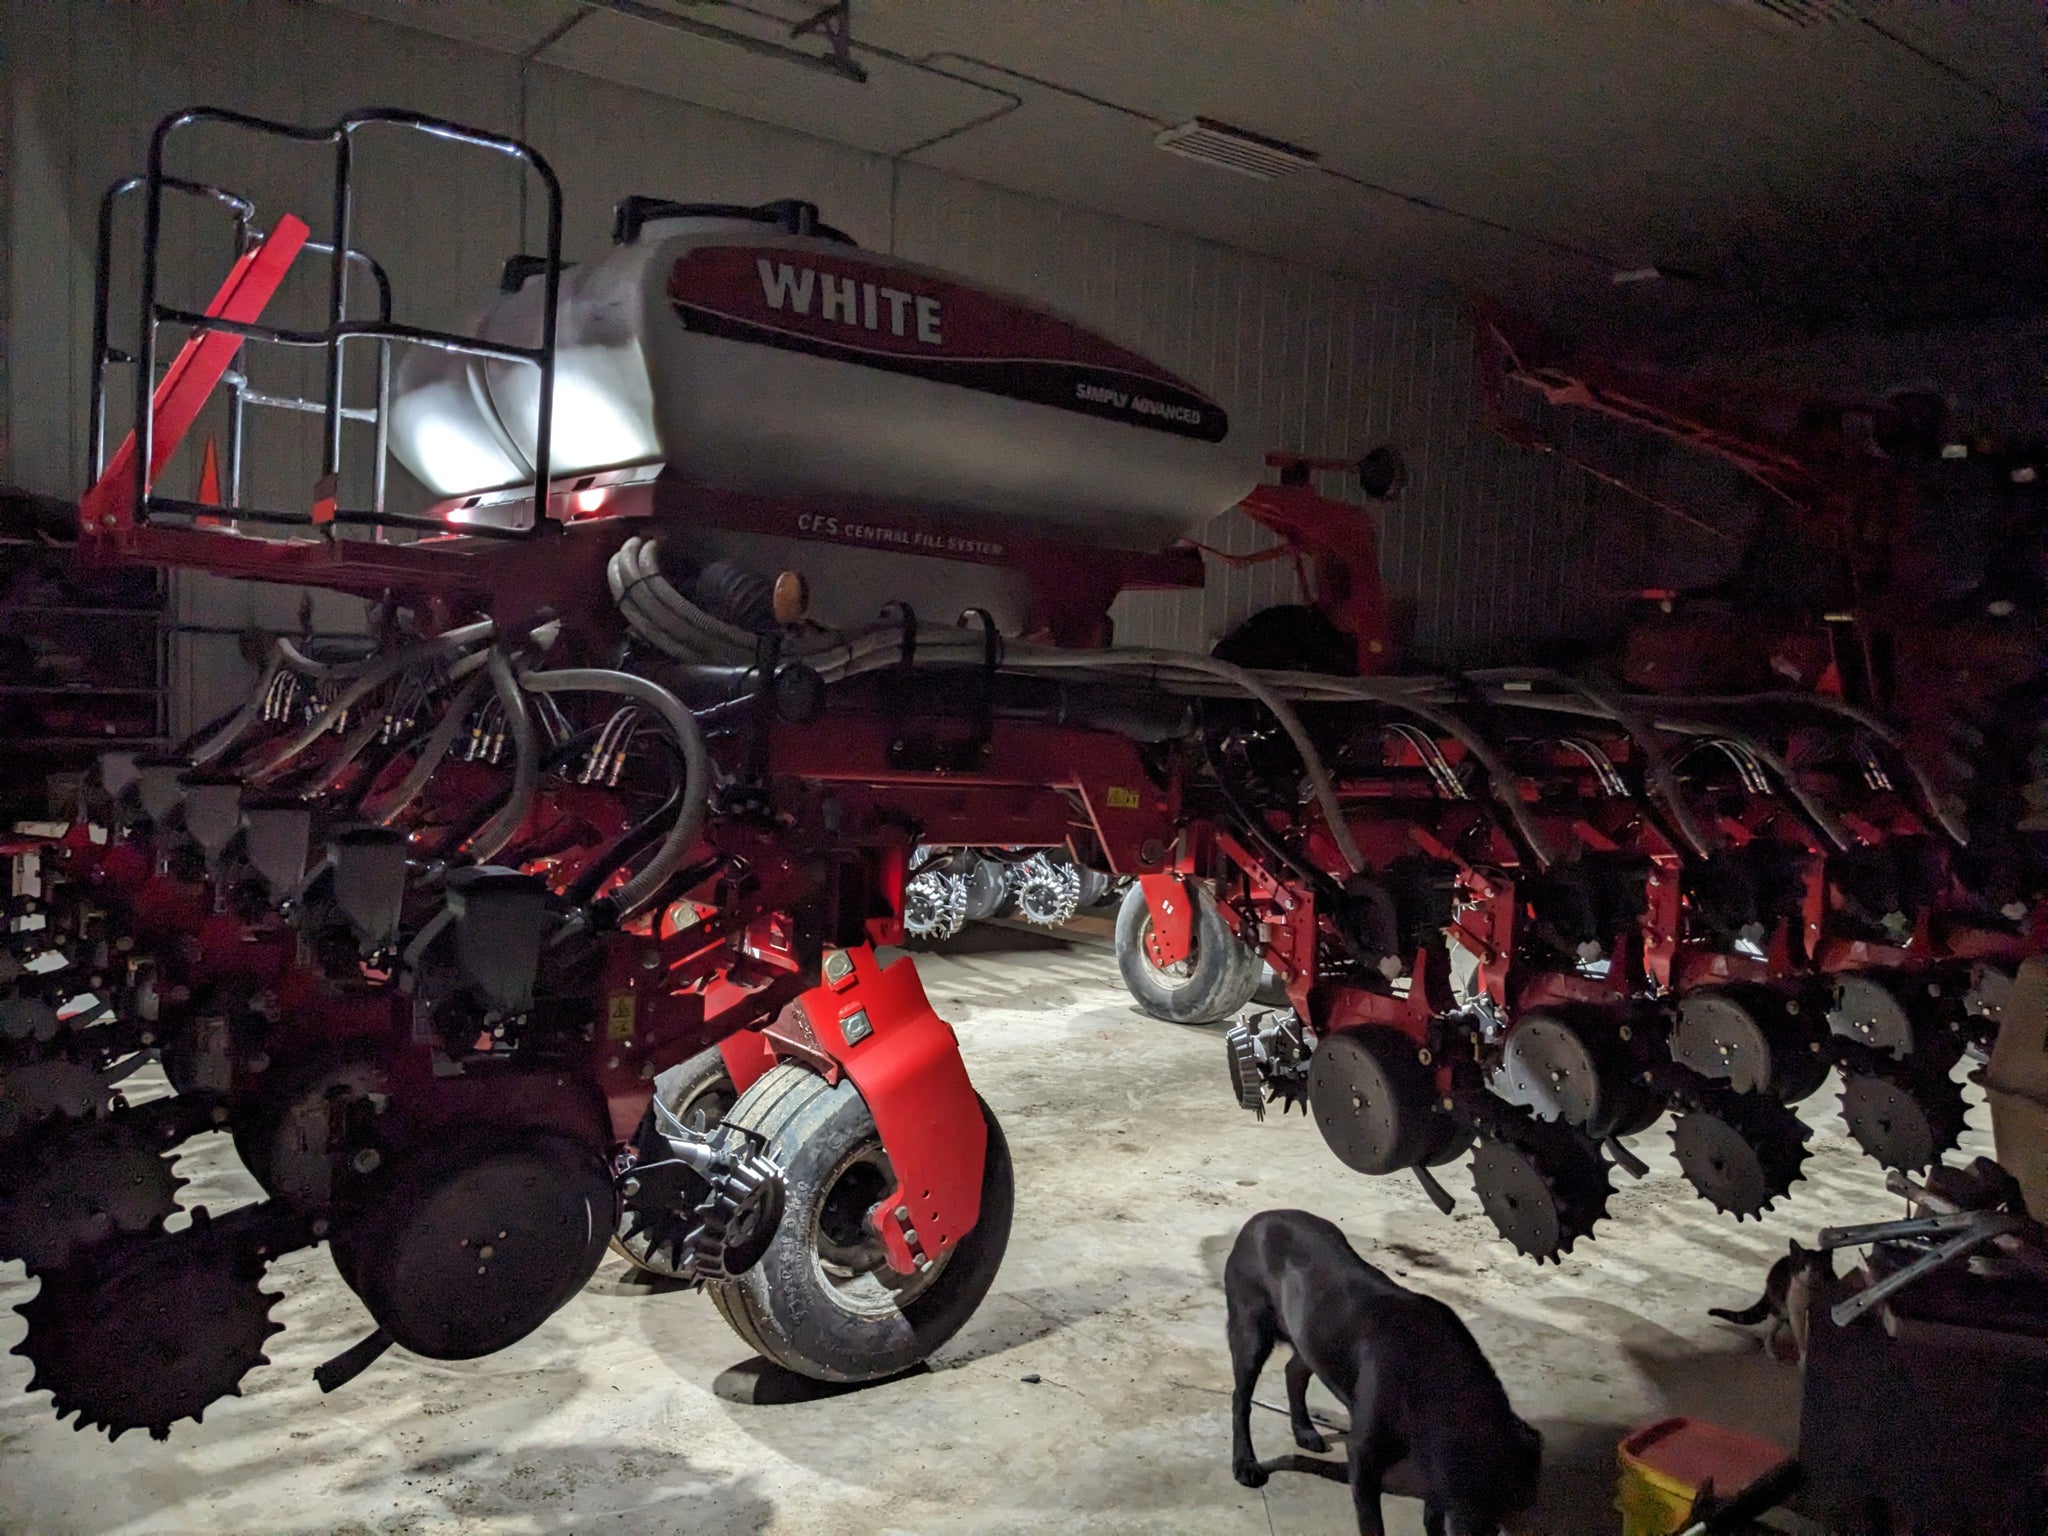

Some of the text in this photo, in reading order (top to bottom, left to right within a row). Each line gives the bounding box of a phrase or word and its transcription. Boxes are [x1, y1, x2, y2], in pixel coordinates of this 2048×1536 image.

[756, 258, 943, 345] WHITE
[1075, 383, 1201, 424] SIMPLY ADVANCED
[798, 513, 1004, 554] CFS CENTRAL FILL SYSTEM
